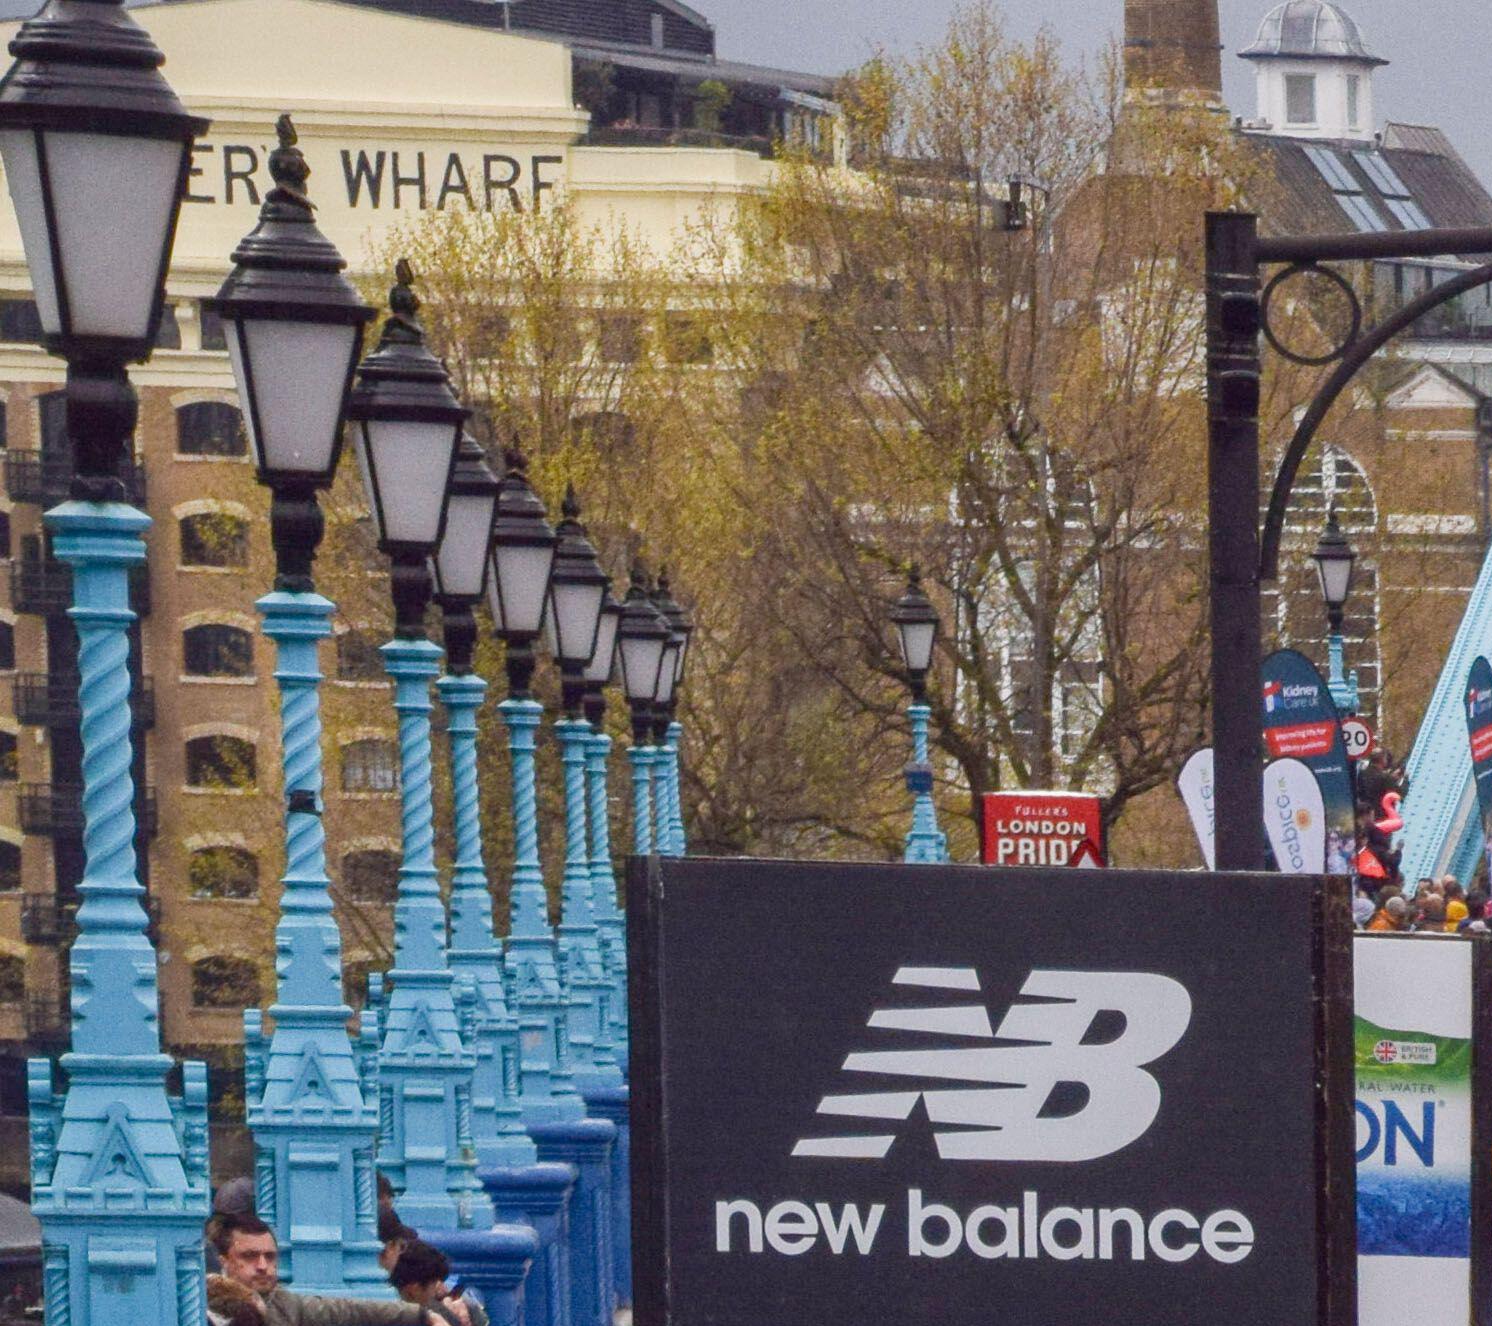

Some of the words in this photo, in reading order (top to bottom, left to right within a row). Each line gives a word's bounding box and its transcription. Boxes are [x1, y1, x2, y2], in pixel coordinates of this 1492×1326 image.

[341, 149, 563, 212] WHARF
[1283, 685, 1318, 698] Kidney
[1342, 730, 1367, 746] 20
[997, 820, 1086, 835] LONDON
[998, 840, 1081, 865] PRID
[1389, 1083, 1435, 1093] WATER
[716, 1199, 886, 1255] new
[908, 1189, 1254, 1262] balance
